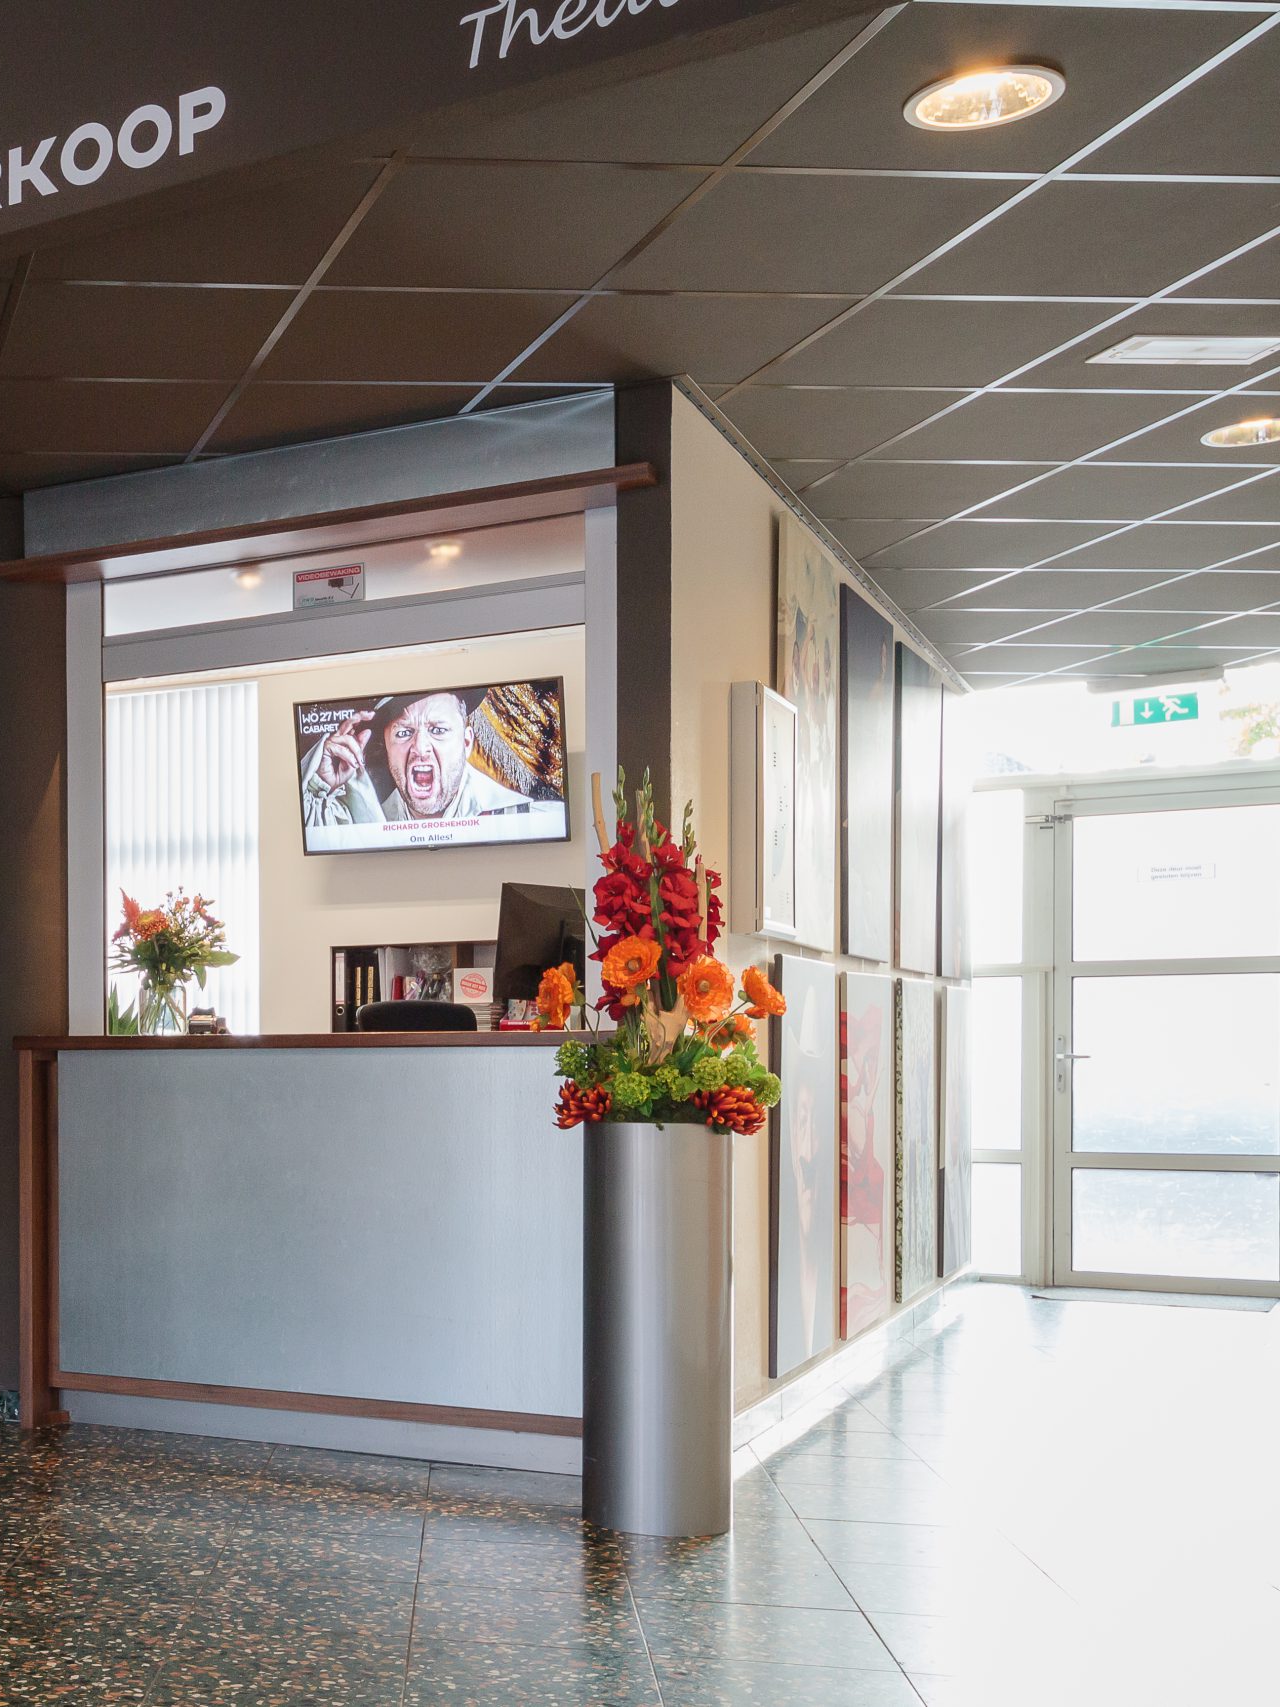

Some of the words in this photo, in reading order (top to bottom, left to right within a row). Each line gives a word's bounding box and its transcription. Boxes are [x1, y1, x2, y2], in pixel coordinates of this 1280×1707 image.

[297, 566, 361, 582] VIDEOBEWAKING
[302, 711, 319, 724] WO
[319, 710, 333, 722] 27
[333, 708, 355, 721] MRT
[303, 723, 339, 735] CABARET
[382, 821, 420, 832] RICHARD
[421, 818, 480, 830] GROENENDIJK
[409, 833, 426, 844] Om
[427, 833, 453, 843] Alles!
